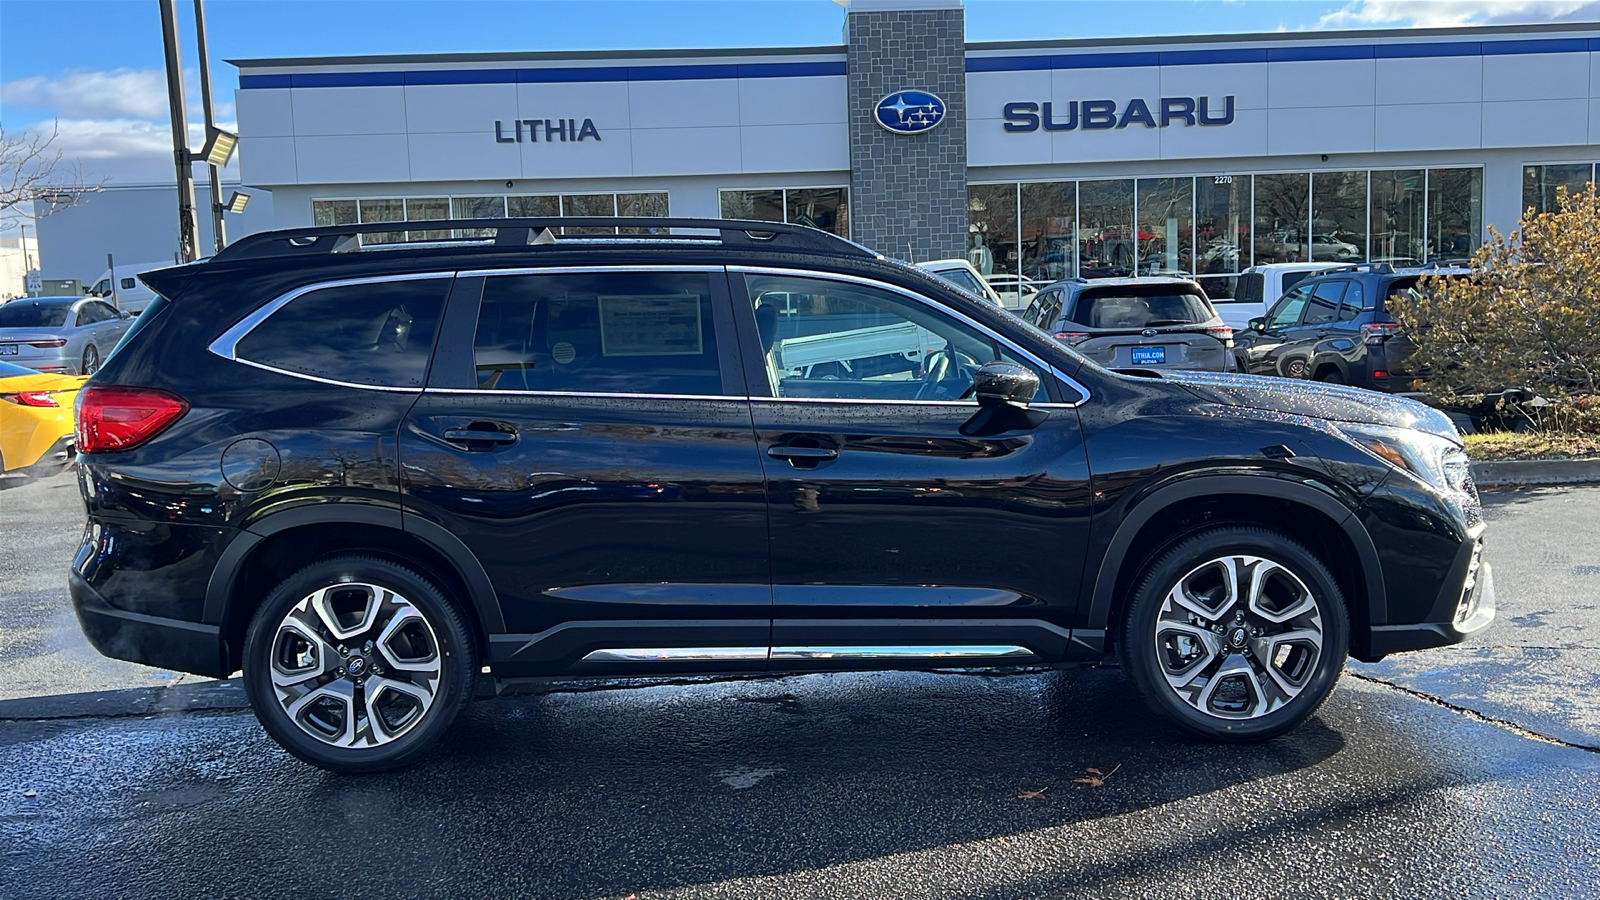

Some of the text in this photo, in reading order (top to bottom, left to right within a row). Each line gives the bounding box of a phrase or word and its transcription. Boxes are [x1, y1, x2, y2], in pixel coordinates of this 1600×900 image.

[1003, 95, 1235, 132] SUBARU
[495, 118, 602, 143] LITHIA
[1214, 175, 1233, 184] 2270
[1132, 351, 1164, 359] LITHIA.COM
